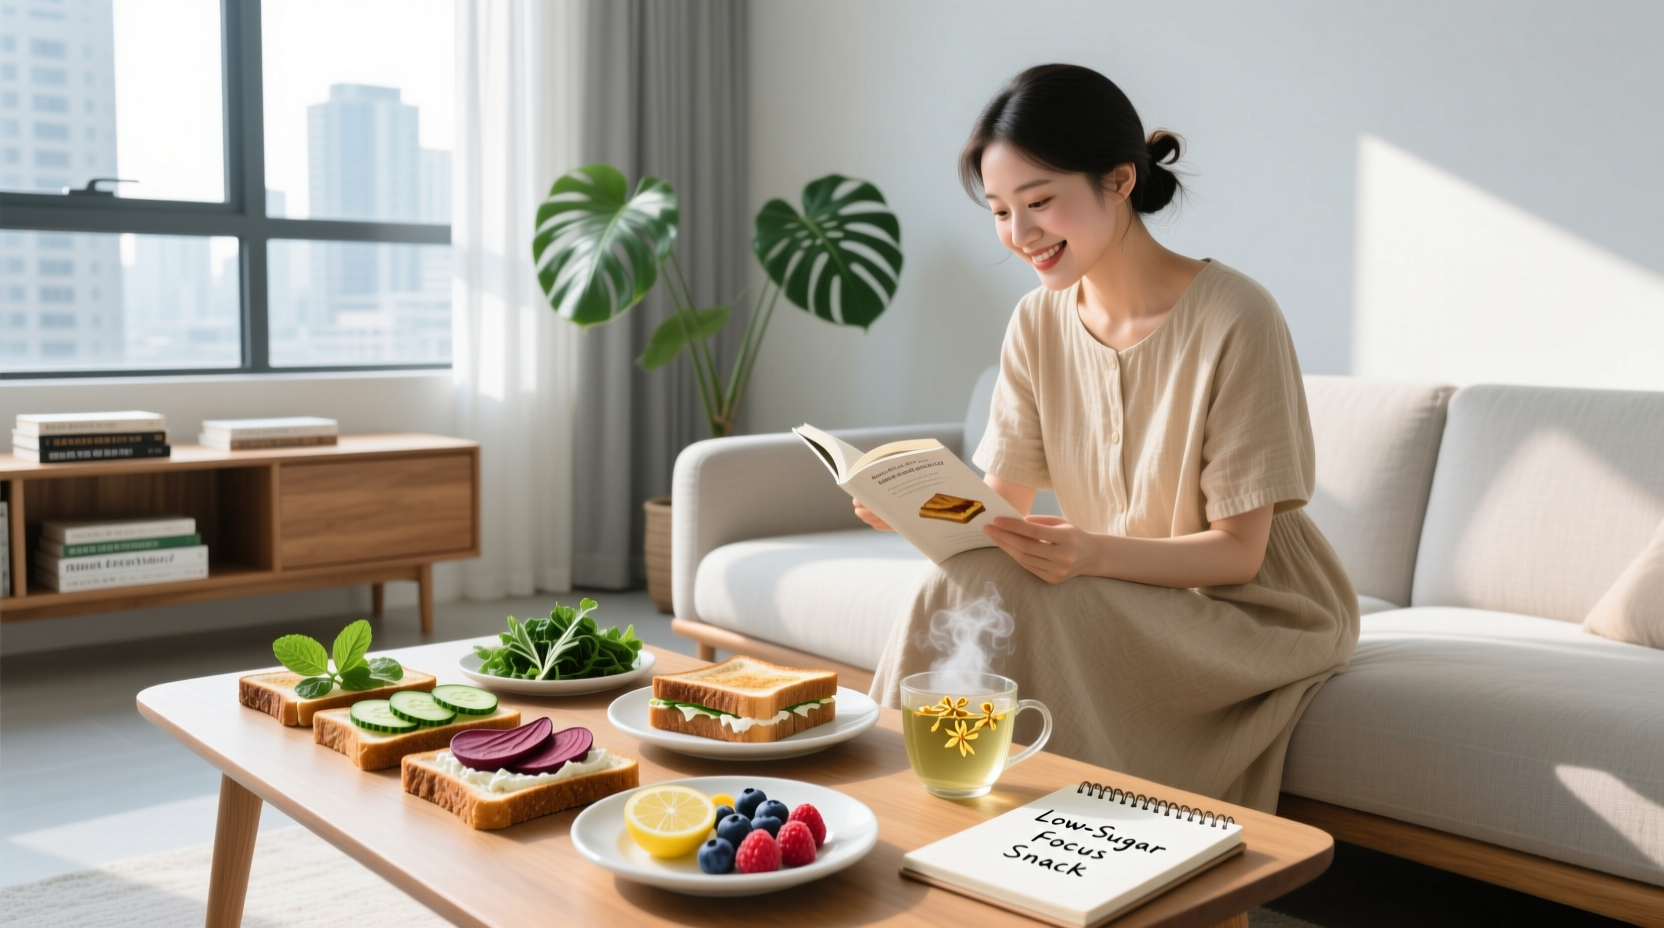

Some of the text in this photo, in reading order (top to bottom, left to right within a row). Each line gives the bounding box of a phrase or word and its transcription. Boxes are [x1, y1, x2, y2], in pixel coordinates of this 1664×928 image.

[1031, 831, 1107, 860] Focus
[1034, 809, 1166, 854] Low-Sugar
[1003, 844, 1087, 877] Snack
